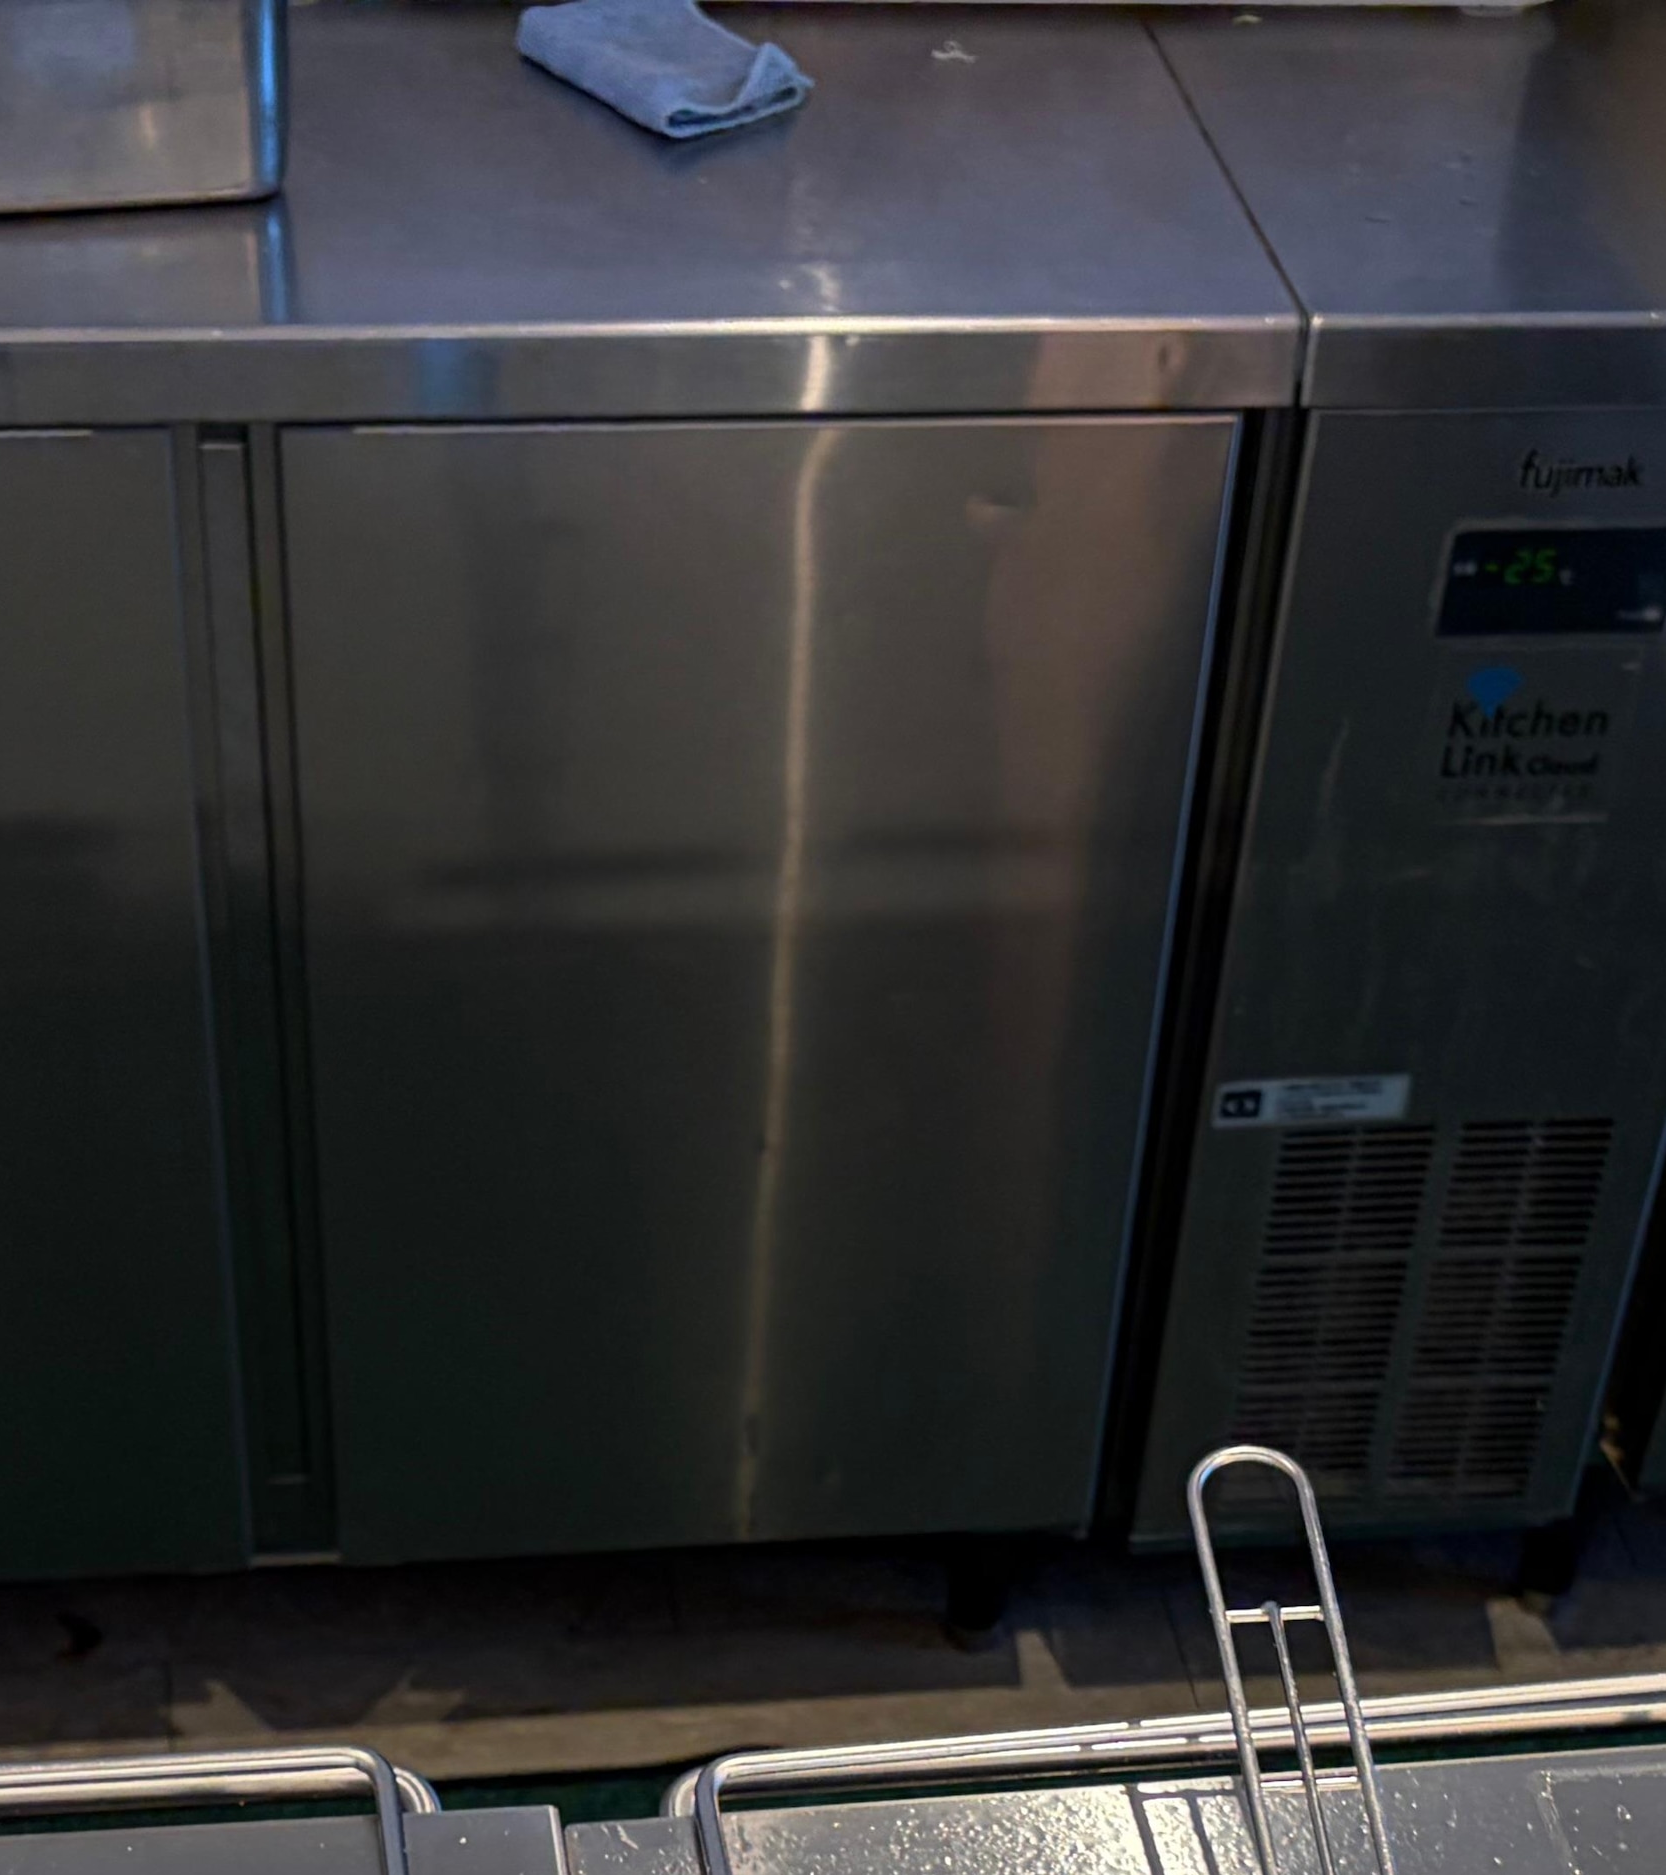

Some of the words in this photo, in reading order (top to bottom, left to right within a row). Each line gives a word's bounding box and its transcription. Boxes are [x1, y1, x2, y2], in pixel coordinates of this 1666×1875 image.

[1520, 450, 1644, 498] fujimak
[1447, 701, 1611, 739] Kitchen
[1440, 747, 1523, 779] Link
